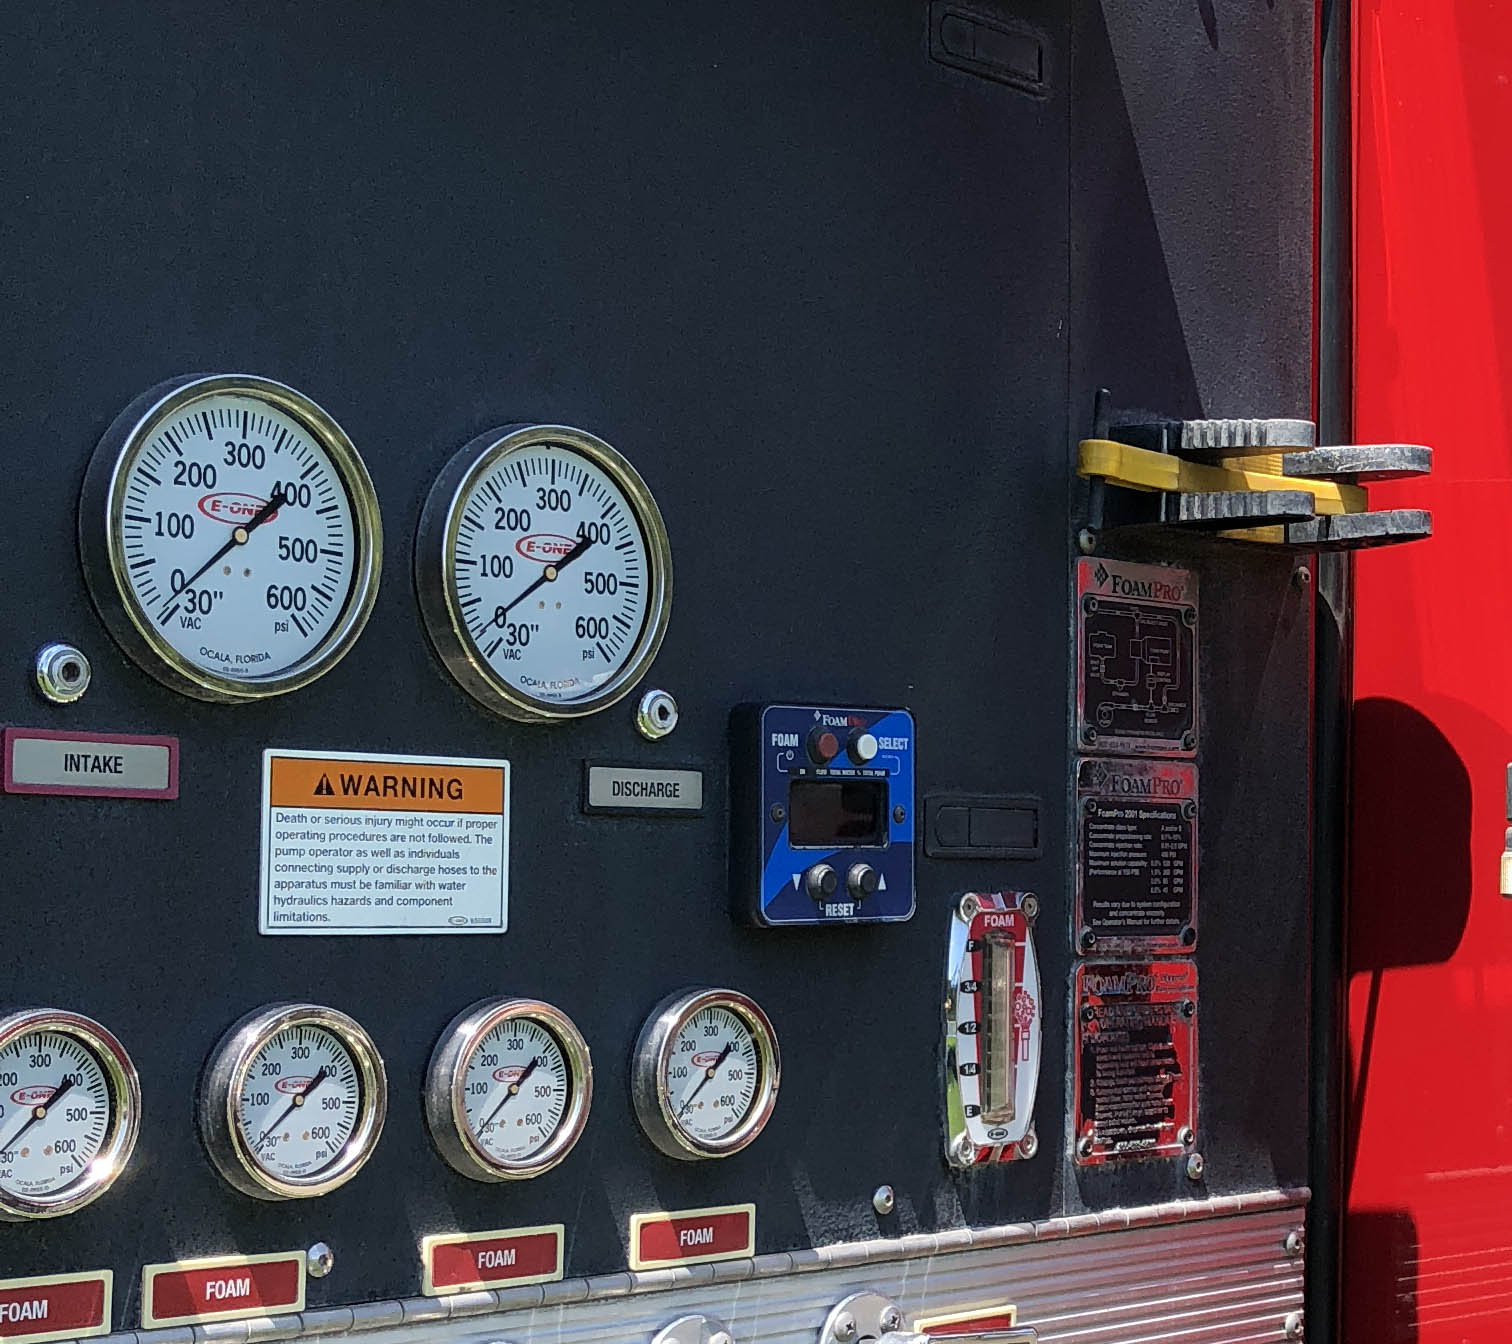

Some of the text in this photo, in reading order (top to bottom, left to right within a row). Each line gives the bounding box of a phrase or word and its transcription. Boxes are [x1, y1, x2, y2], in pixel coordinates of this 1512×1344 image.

[223, 441, 266, 470] 300
[173, 460, 217, 489] 200
[535, 487, 572, 513] 300
[154, 511, 195, 539] 100
[494, 507, 531, 532] 200
[278, 536, 318, 564] 500
[480, 554, 513, 579] 100
[170, 568, 185, 593] 0
[584, 571, 618, 596] 500
[266, 584, 307, 612] 600
[180, 615, 202, 630] VAC
[494, 605, 507, 629] 0
[274, 619, 289, 634] psi
[575, 615, 609, 640] 600
[199, 646, 272, 664] OCALA, FLORIDA
[503, 648, 522, 661] VAC
[582, 647, 595, 661] psi
[771, 733, 799, 748] FOAM
[878, 737, 909, 751] SELECT
[64, 753, 124, 774] INTAKE
[339, 773, 464, 801] WARNING
[612, 780, 680, 798] DISCHARGE
[275, 812, 498, 830] Death or serious injury might occur if proper
[275, 830, 493, 845] operating procedures are not followed. The
[274, 847, 460, 861] pump operator as well as individuals
[274, 862, 498, 877] connecting supply or discharge hoses to the
[273, 878, 467, 893] apparatus must be familiar with water
[273, 895, 454, 909] hydraulics hazards and component
[273, 911, 331, 923] limitations.
[825, 903, 855, 917] RESET
[984, 914, 1015, 927] FOAM
[968, 941, 974, 950] F
[703, 1026, 719, 1037] 300
[506, 1038, 524, 1051] 300
[680, 1039, 697, 1052] 200
[29, 1053, 52, 1068] 300
[291, 1046, 310, 1060] 300
[480, 1054, 499, 1067] 200
[261, 1062, 282, 1076] 200
[672, 1066, 688, 1079] 100
[727, 1069, 743, 1082] 500
[470, 1082, 488, 1095] 100
[534, 1086, 551, 1098] 500
[250, 1092, 270, 1107] 100
[321, 1097, 341, 1111] 500
[720, 1095, 735, 1107] 600
[66, 1108, 88, 1122] 500
[525, 1112, 543, 1125] 600
[966, 1107, 973, 1117] E
[311, 1126, 330, 1140] 600
[54, 1139, 76, 1154] 600
[60, 1164, 74, 1176] psi
[679, 1227, 713, 1247] FOAM
[477, 1248, 516, 1269] FOAM
[205, 1278, 250, 1301] FOAM
[0, 1299, 48, 1323] FOAM
